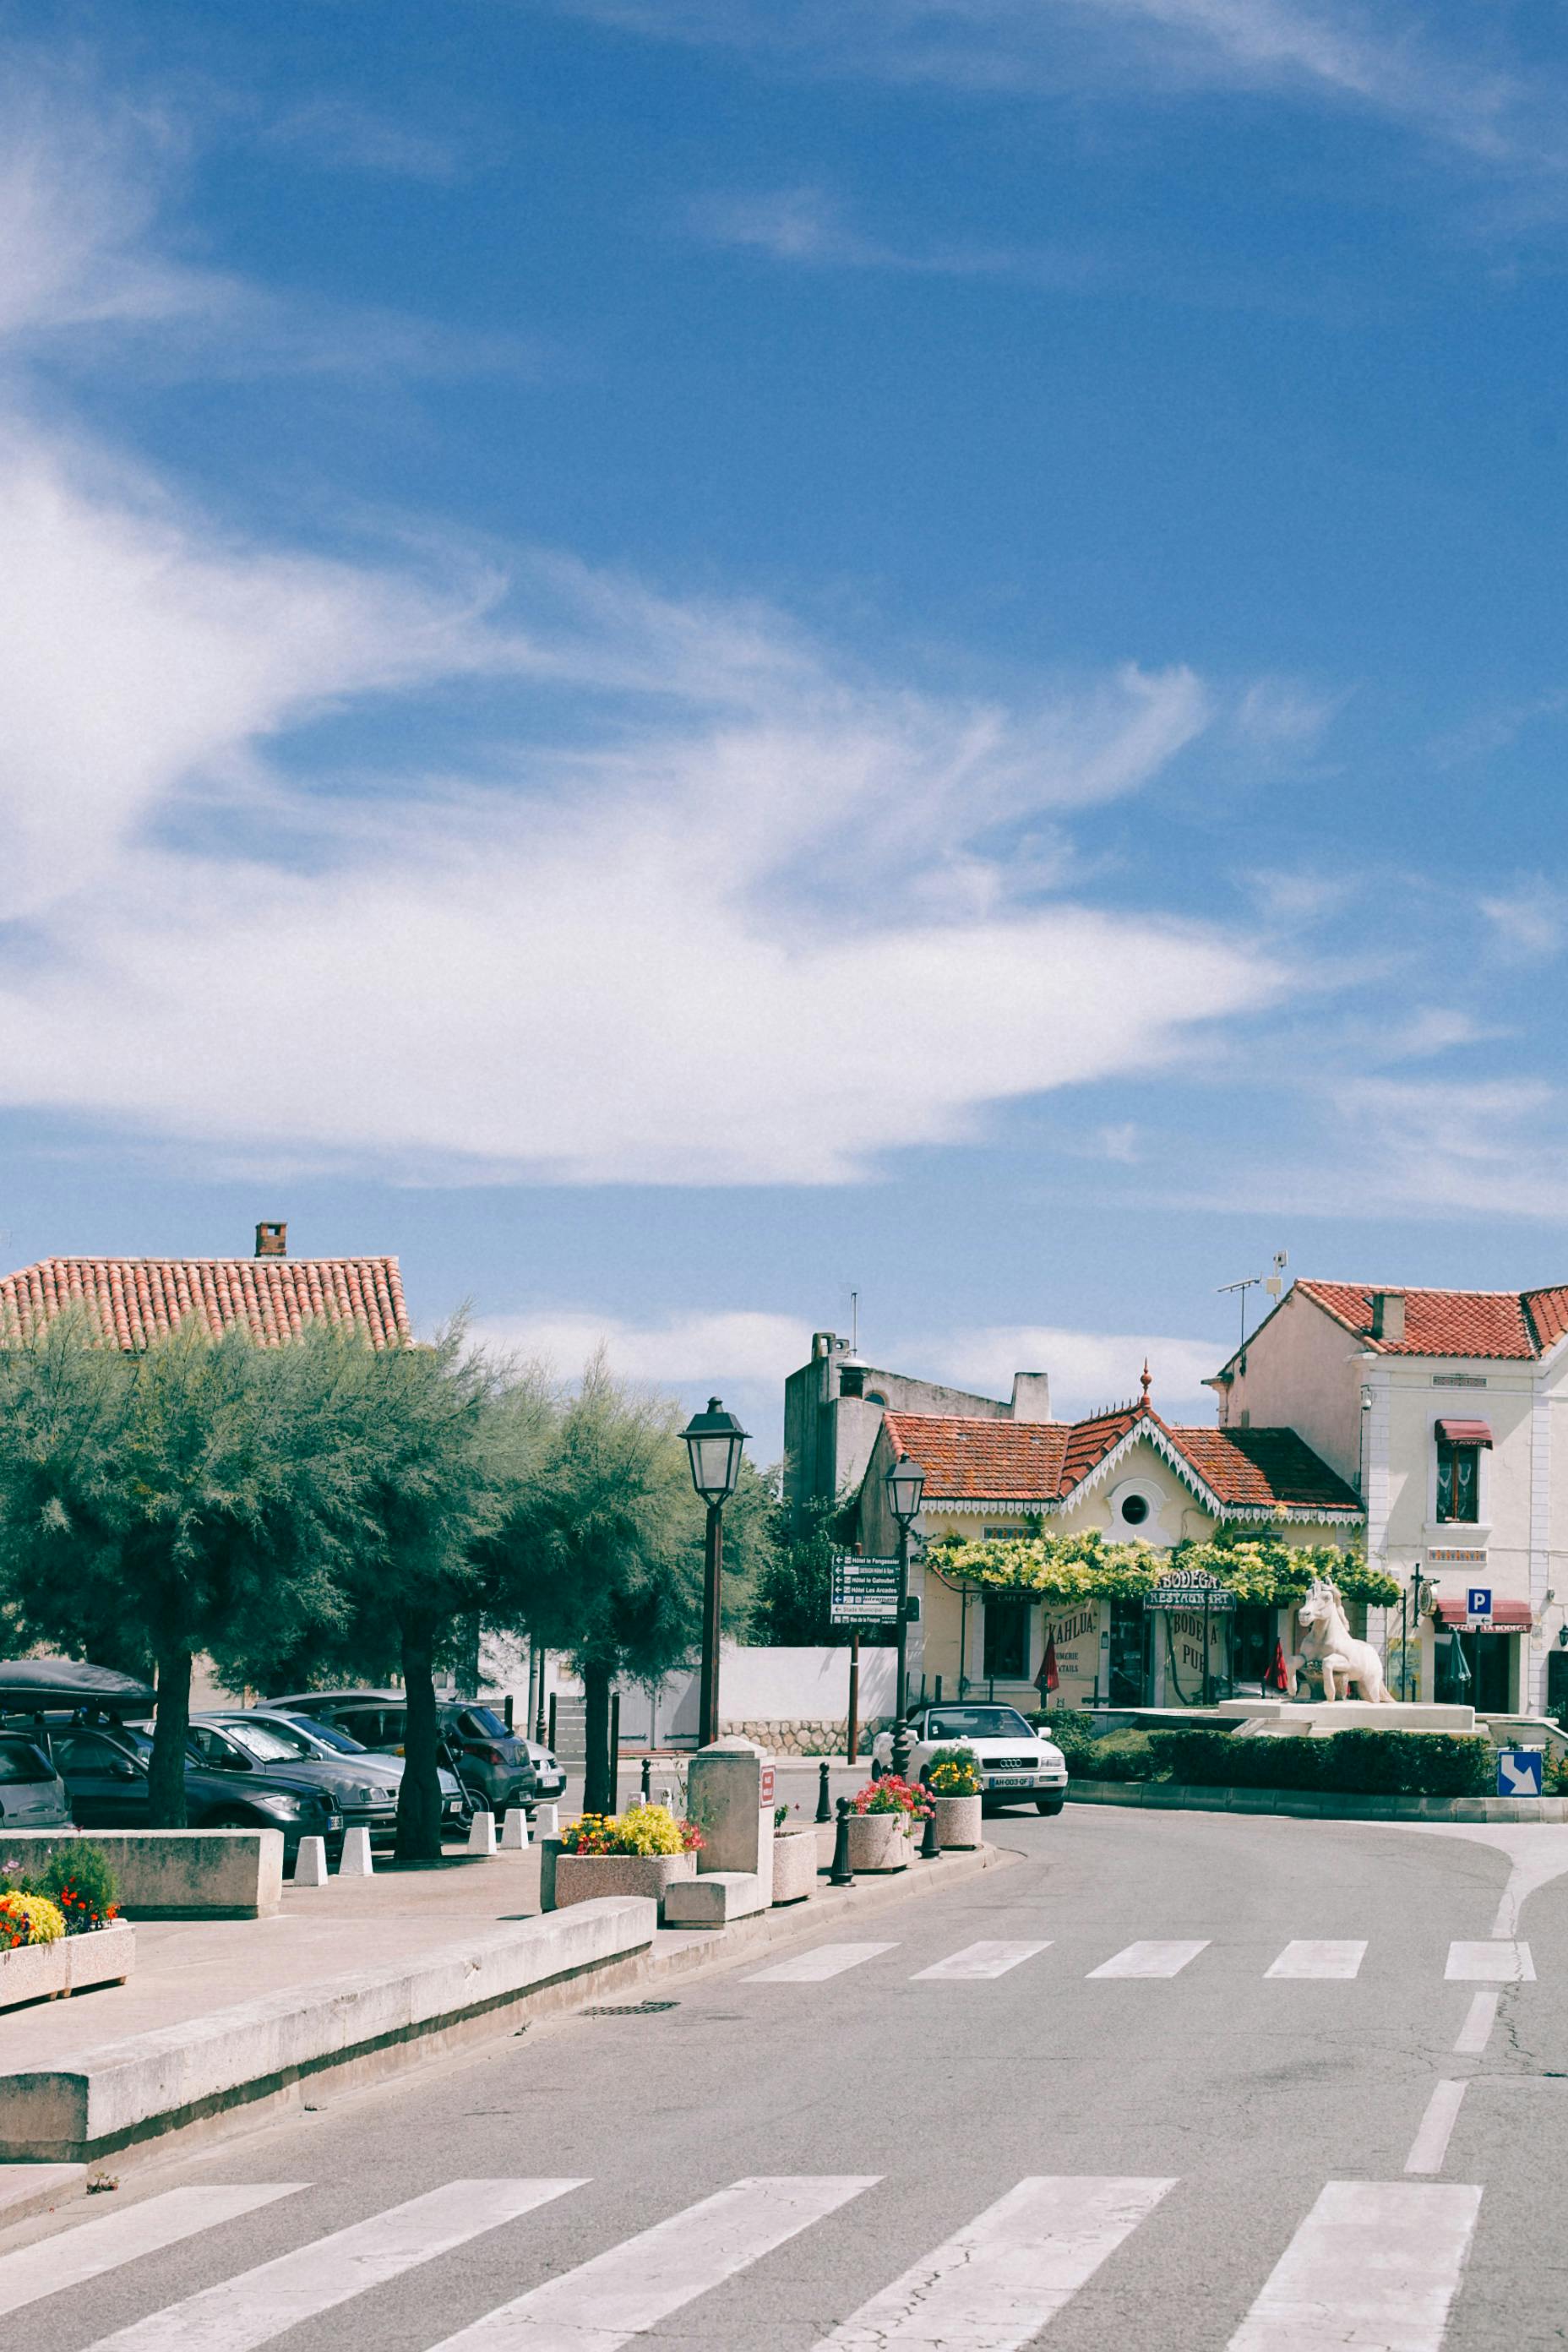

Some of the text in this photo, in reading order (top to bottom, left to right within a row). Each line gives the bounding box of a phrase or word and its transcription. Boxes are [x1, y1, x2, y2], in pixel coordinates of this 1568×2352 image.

[1162, 1571, 1218, 1589] BODEGA
[1473, 1592, 1486, 1610] P
[1048, 1612, 1093, 1645] KAHLUA
[1174, 1613, 1217, 1646] BODEA
